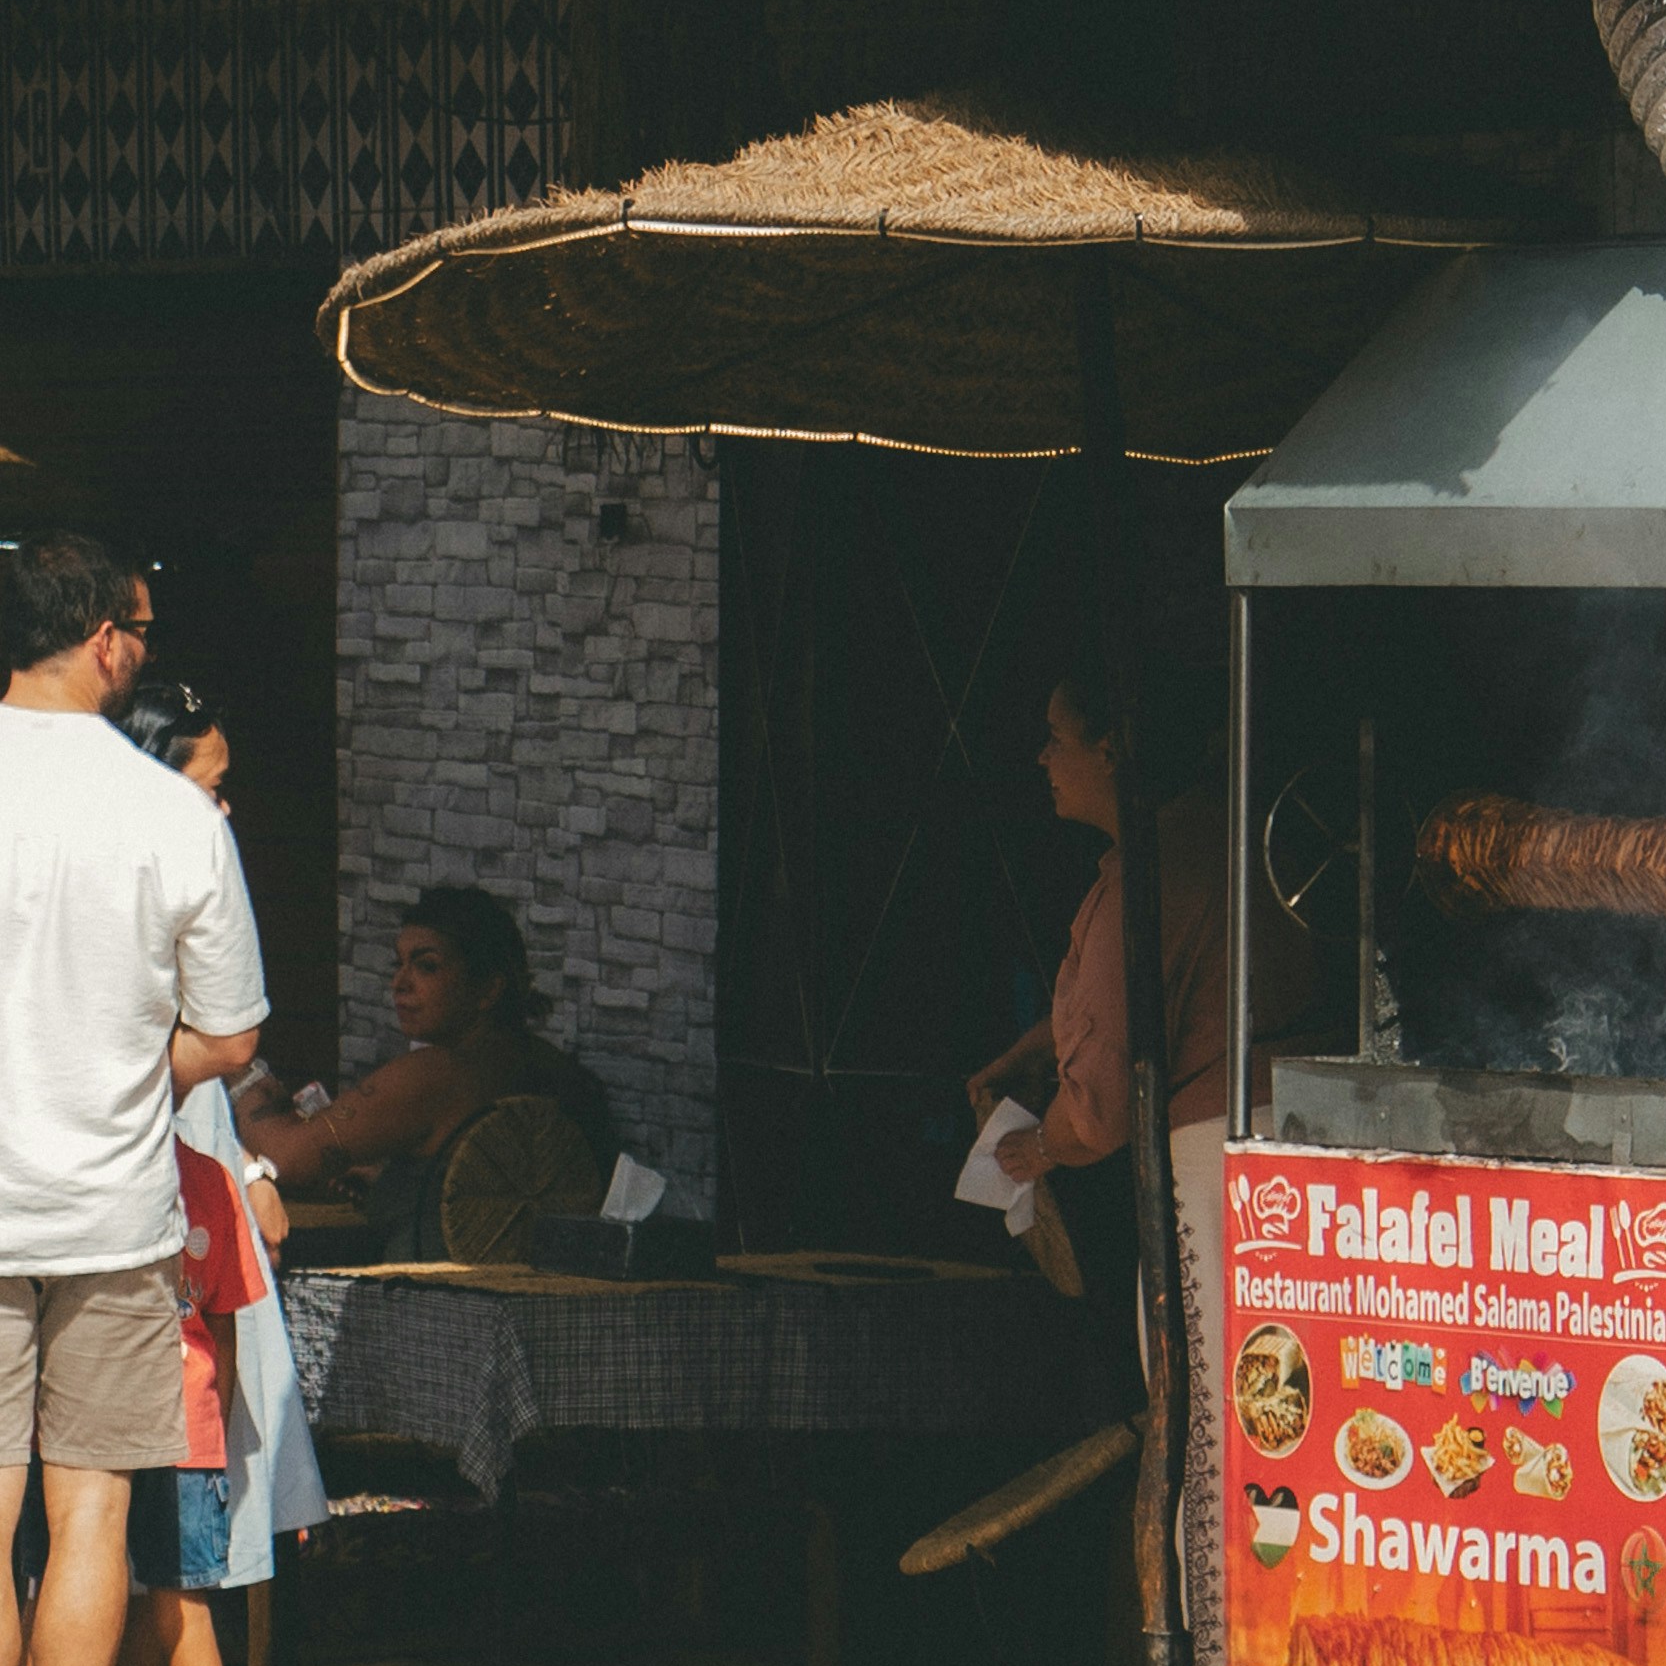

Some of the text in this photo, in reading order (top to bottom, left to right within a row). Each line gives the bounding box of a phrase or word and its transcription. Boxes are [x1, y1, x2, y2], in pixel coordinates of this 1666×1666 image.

[1306, 1183, 1605, 1279] Falafel Meal
[1235, 1266, 1352, 1315] Restaurant
[1356, 1276, 1470, 1326] Mohamed
[1474, 1285, 1552, 1335] Salama
[1308, 1492, 1607, 1595] Shawarma
